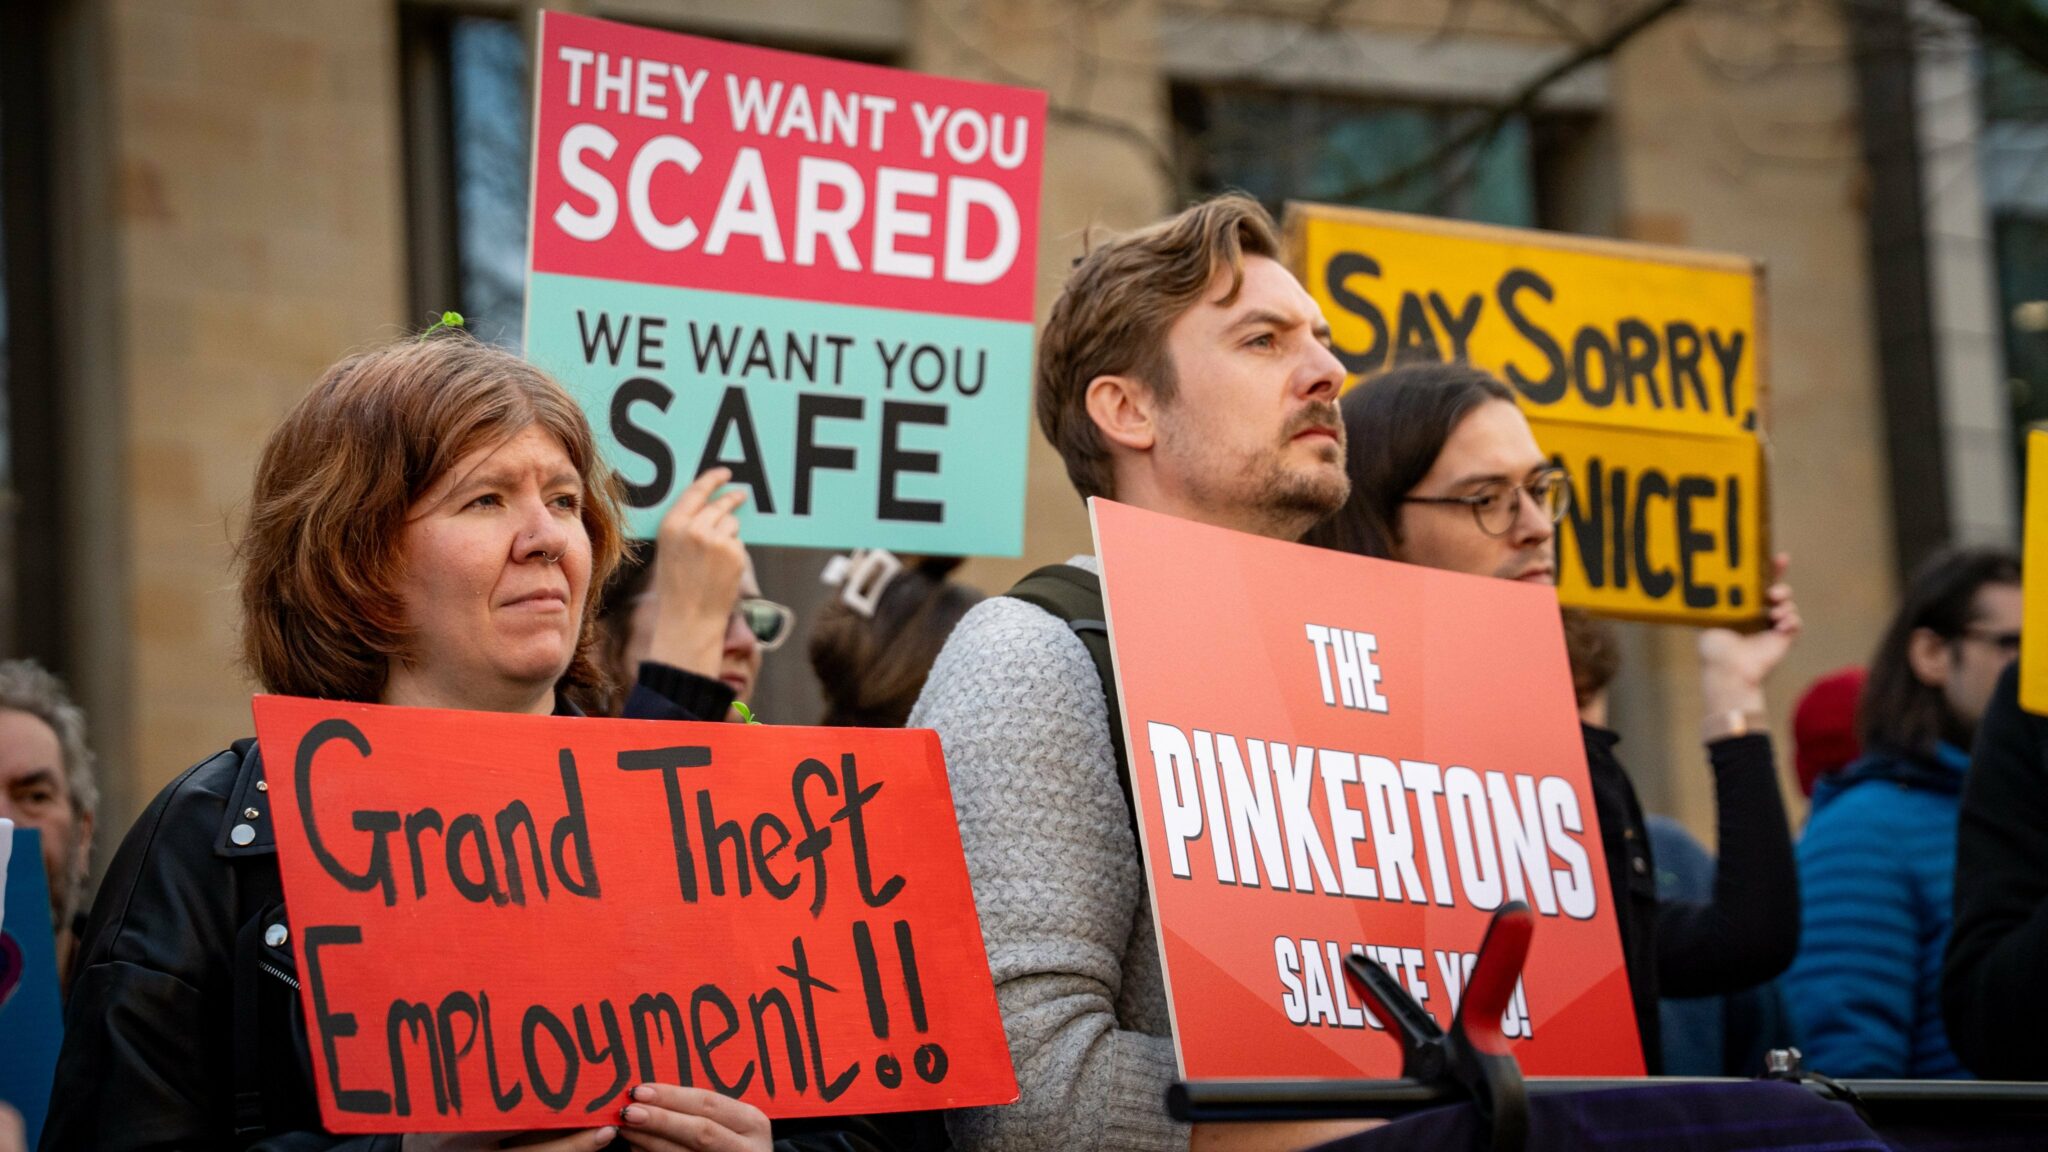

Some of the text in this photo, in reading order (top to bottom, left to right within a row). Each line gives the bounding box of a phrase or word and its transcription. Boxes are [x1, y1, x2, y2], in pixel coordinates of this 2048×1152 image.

[557, 46, 1029, 169] THEY WANT YOU
[552, 123, 1021, 285] SCARED
[576, 309, 987, 396] WE WANT YOU
[609, 377, 949, 524] SAFE
[1551, 454, 1744, 608] NICE!
[1305, 623, 1390, 713] THE
[294, 718, 906, 917] Grand Theft
[1147, 720, 1597, 920] PINKERTONS
